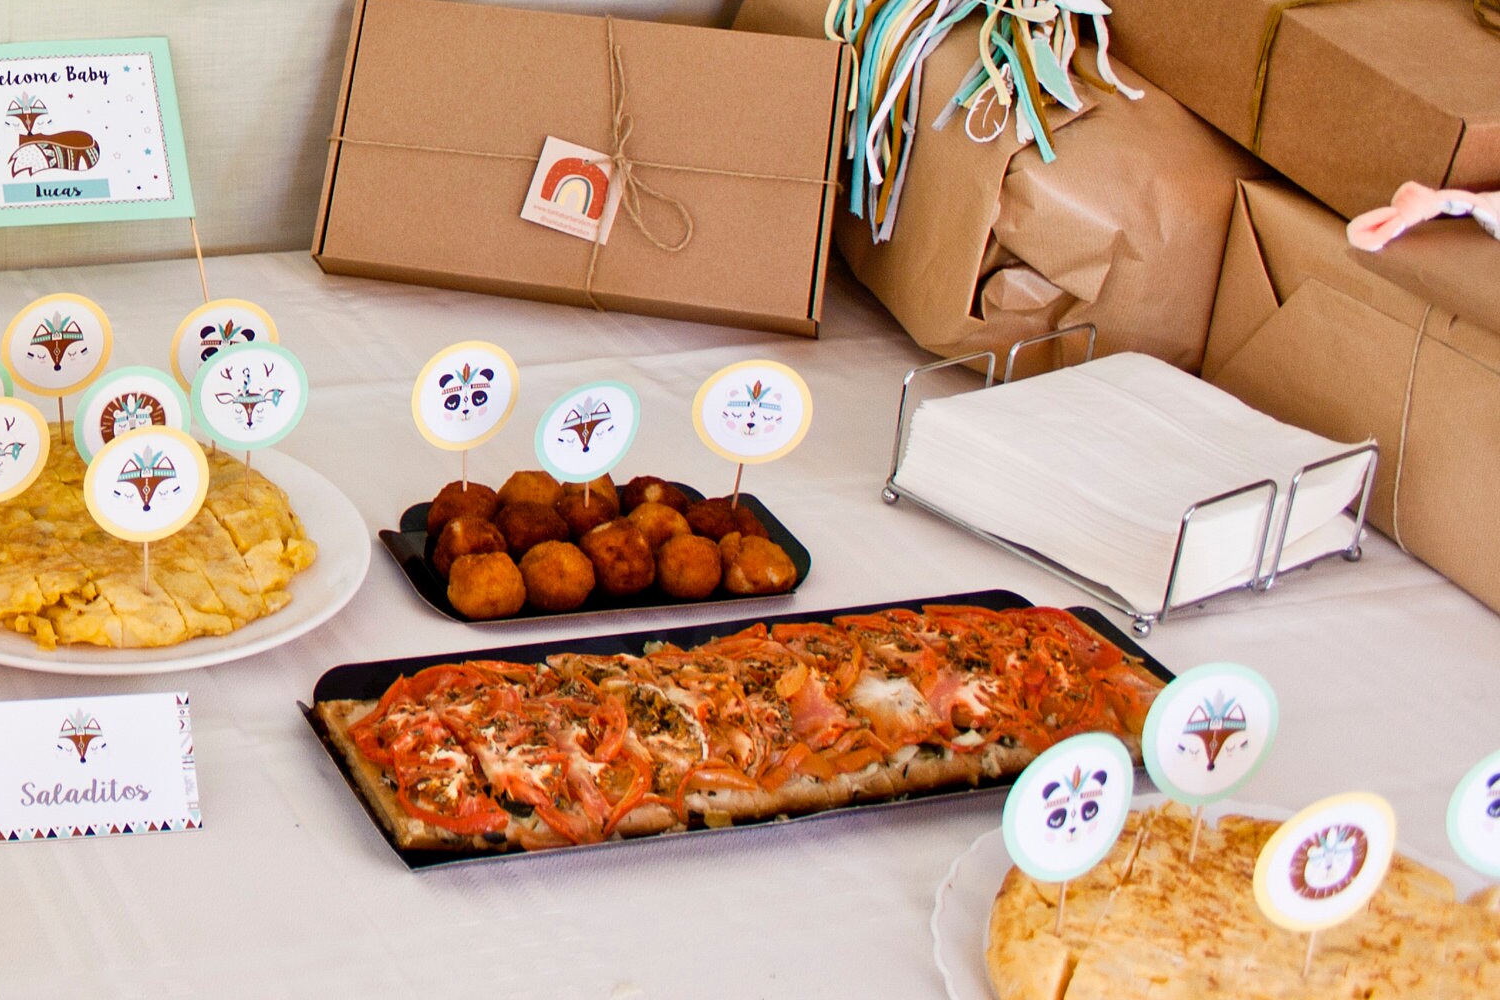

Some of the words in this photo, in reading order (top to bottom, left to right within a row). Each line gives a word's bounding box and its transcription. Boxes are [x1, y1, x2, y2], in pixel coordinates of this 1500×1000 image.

[65, 65, 110, 86] Baby
[35, 183, 83, 198] Lucas
[20, 778, 152, 807] Saladitos
